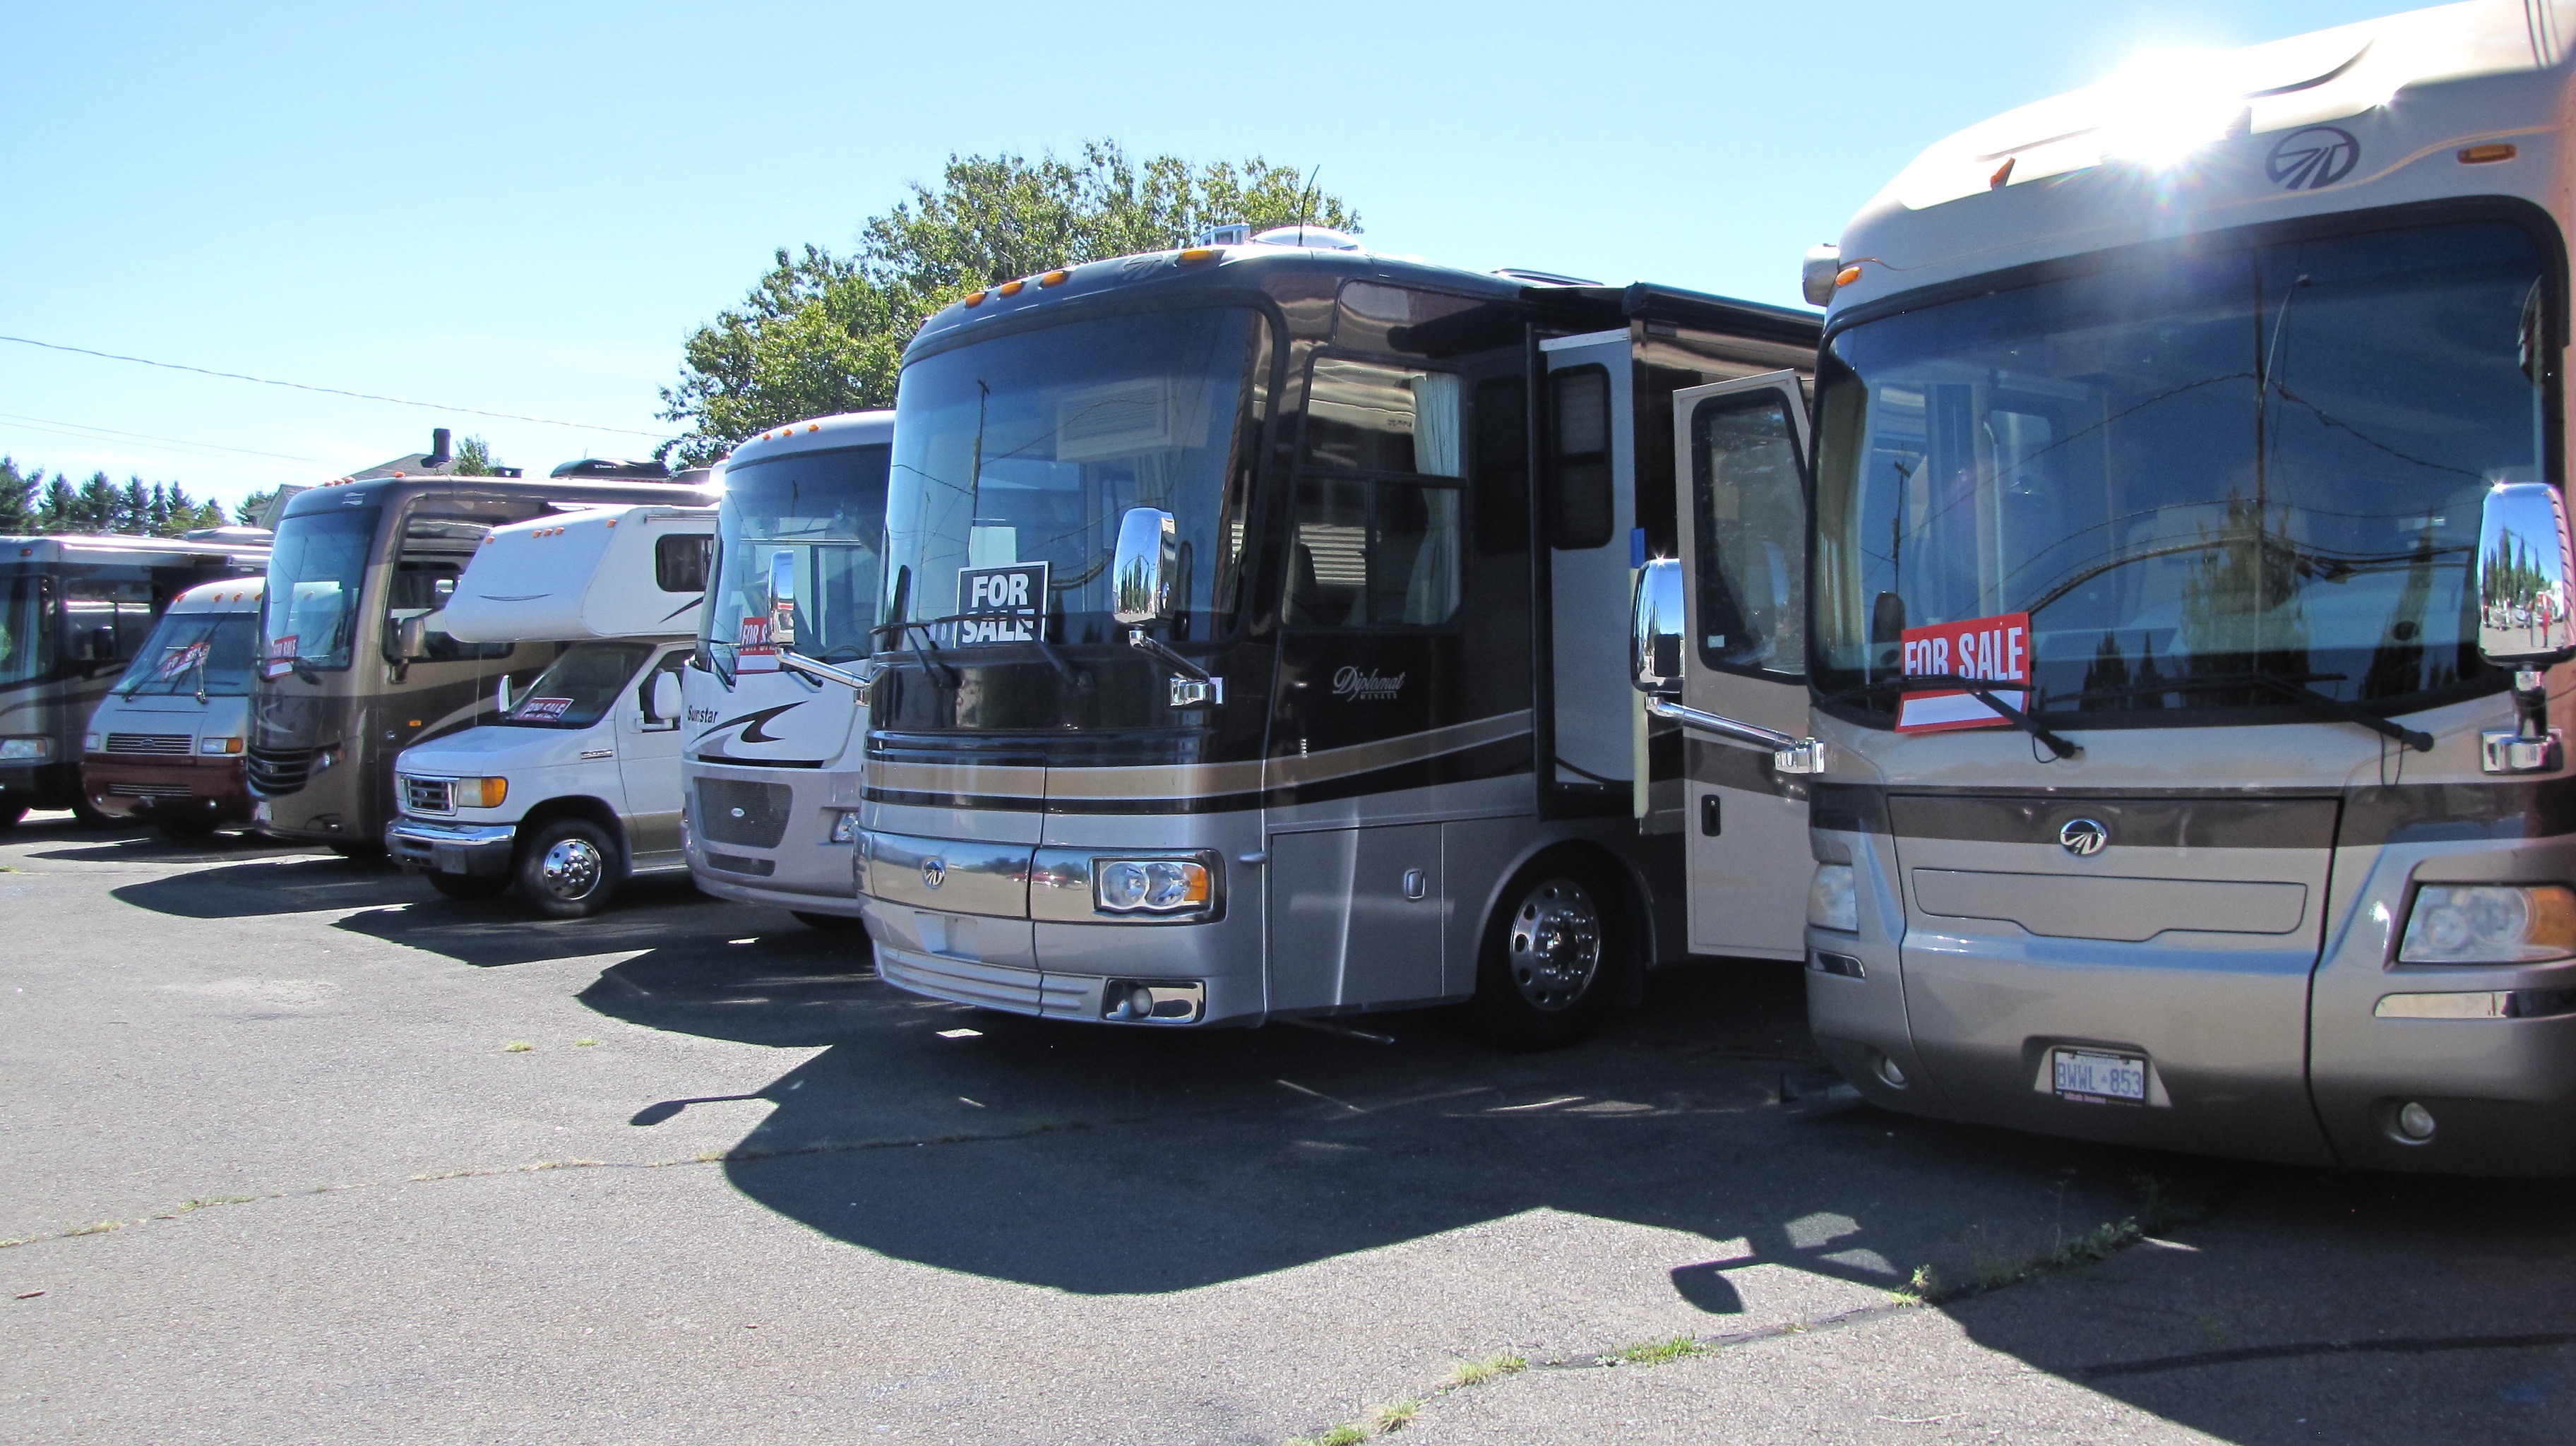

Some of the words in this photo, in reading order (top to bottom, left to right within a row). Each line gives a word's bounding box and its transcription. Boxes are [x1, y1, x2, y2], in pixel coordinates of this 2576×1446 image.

[971, 573, 1029, 608] FOR
[741, 624, 759, 651] FOR
[962, 608, 1035, 643] SALE
[1904, 638, 1949, 675] FOR
[1958, 626, 2023, 681] SALE
[1332, 666, 1405, 702] Diplomat
[687, 705, 718, 723] Sunstar
[2056, 1062, 2096, 1091] BWWL
[2110, 1068, 2142, 1097] 853
